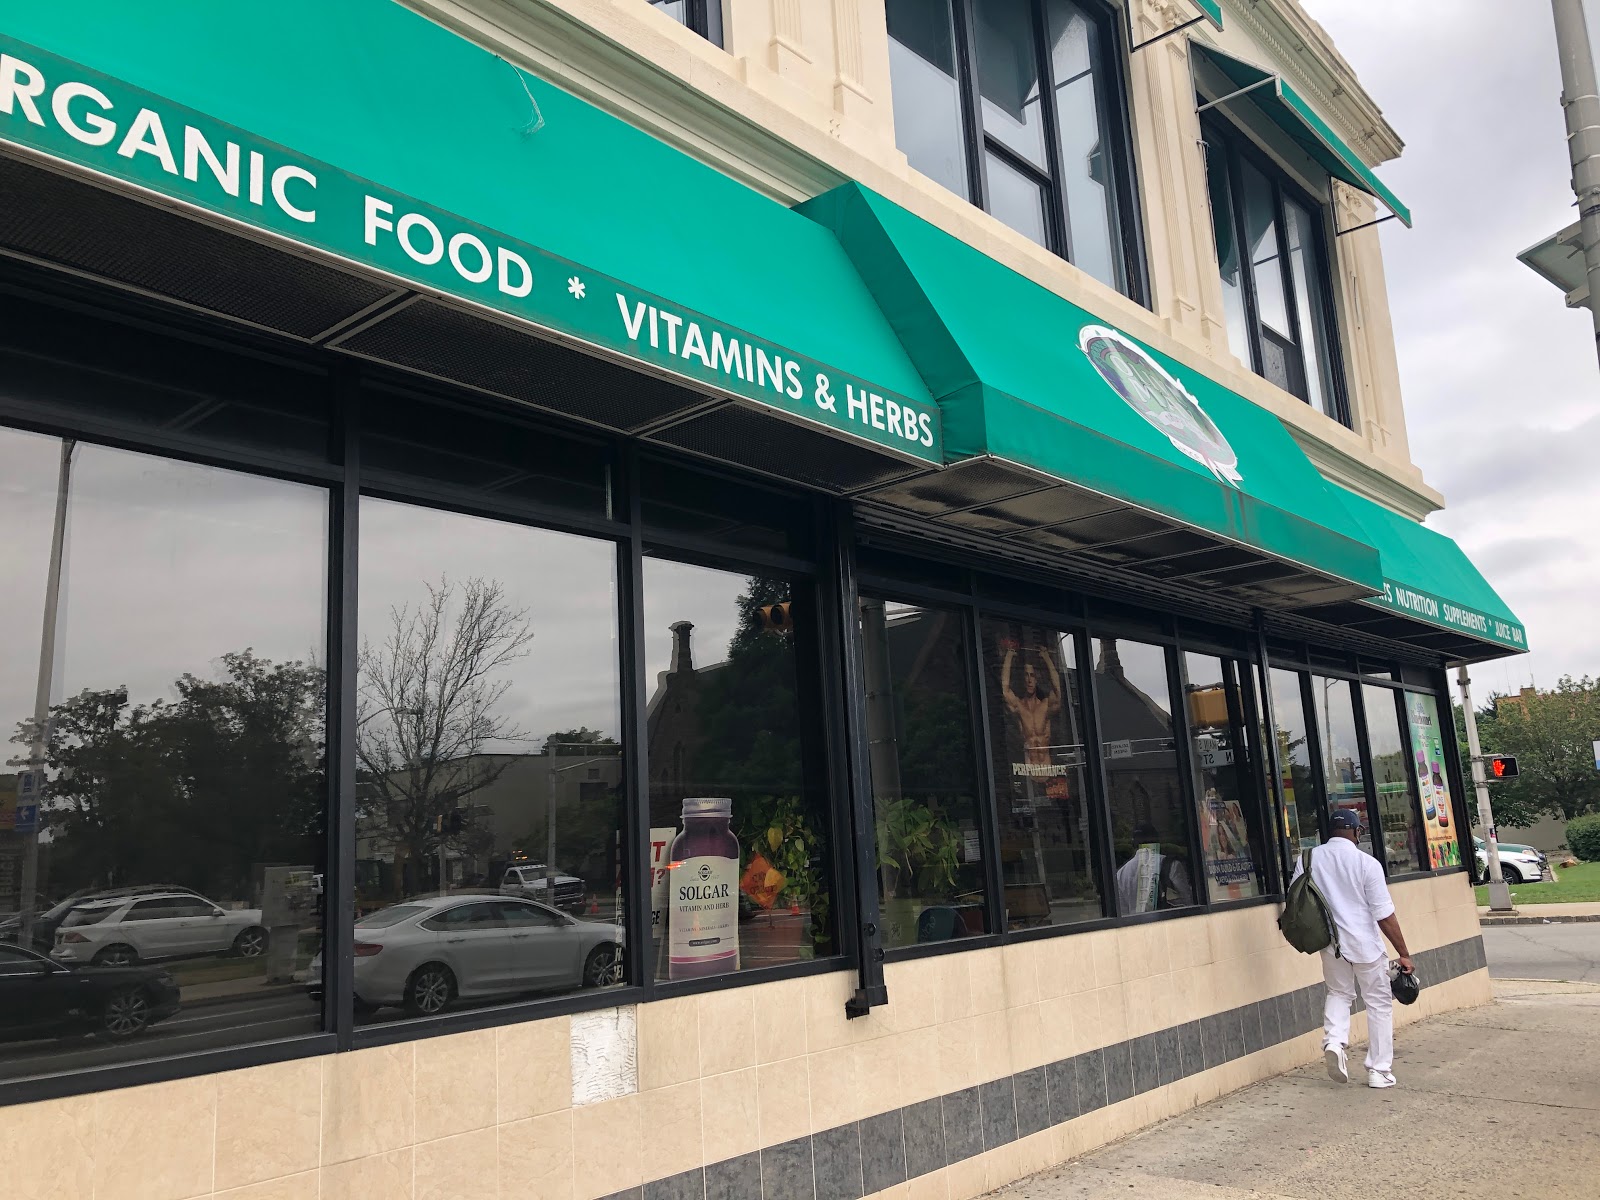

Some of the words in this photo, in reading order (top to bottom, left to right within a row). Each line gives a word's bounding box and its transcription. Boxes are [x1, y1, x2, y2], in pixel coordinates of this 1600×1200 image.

[364, 195, 533, 298] FOOD
[616, 293, 803, 400] VITAMINS
[814, 373, 837, 414] &
[846, 384, 934, 448] HERBS
[1395, 587, 1439, 618] NUTRITION
[1443, 603, 1487, 633] SUPPLEMENTS
[1494, 621, 1511, 641] JUICE
[1511, 626, 1524, 644] BAR
[1012, 763, 1067, 777] PERFORMANCE
[679, 883, 729, 901] SOLGAR
[679, 904, 702, 913] VITAMIN
[703, 903, 715, 911] AND
